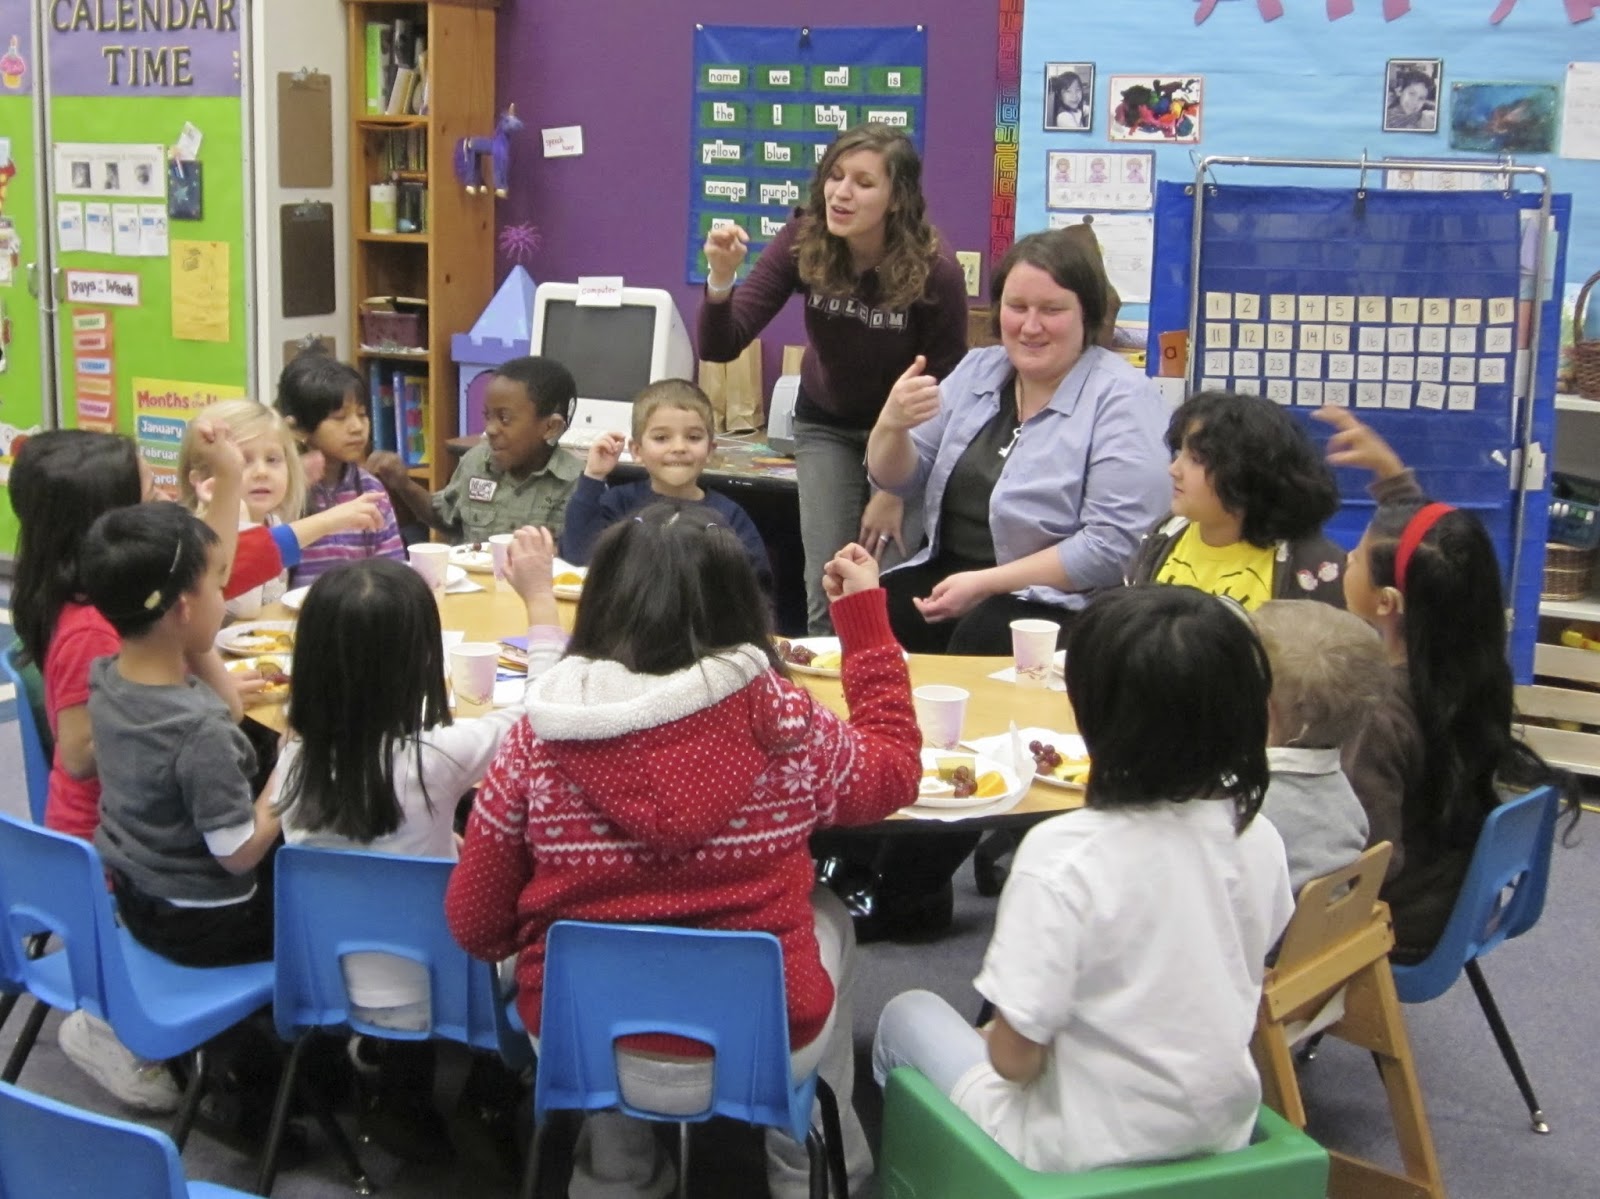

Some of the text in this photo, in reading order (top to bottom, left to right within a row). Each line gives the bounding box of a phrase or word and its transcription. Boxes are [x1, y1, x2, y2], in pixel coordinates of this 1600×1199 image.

[51, 0, 237, 32] CALENDAR
[102, 45, 193, 86] TIME
[710, 73, 738, 82] name
[771, 75, 789, 83] we
[826, 70, 847, 84] and
[889, 73, 899, 85] is
[716, 105, 733, 120] the
[816, 107, 845, 127] baby
[704, 142, 738, 162] yellow
[766, 145, 789, 160] blue
[707, 184, 744, 201] orange
[762, 183, 797, 204] purple
[71, 280, 96, 297] Days
[105, 279, 134, 297] Week
[581, 285, 617, 297] computer
[1243, 298, 1251, 313] 2
[1279, 301, 1287, 314] 3
[1306, 302, 1315, 314] 4
[1335, 302, 1344, 317] 5
[1366, 301, 1375, 314] 6
[1400, 303, 1408, 314] 7
[1429, 303, 1439, 316] 8
[1461, 303, 1471, 318] 9
[1494, 303, 1506, 318] 10
[1212, 328, 1221, 343] 11
[1244, 330, 1257, 343] 12
[1273, 330, 1286, 343] 13
[1306, 330, 1318, 344] 14
[1332, 332, 1343, 345] 15
[137, 390, 189, 408] Months
[141, 421, 182, 438] January
[140, 446, 179, 460] Februar
